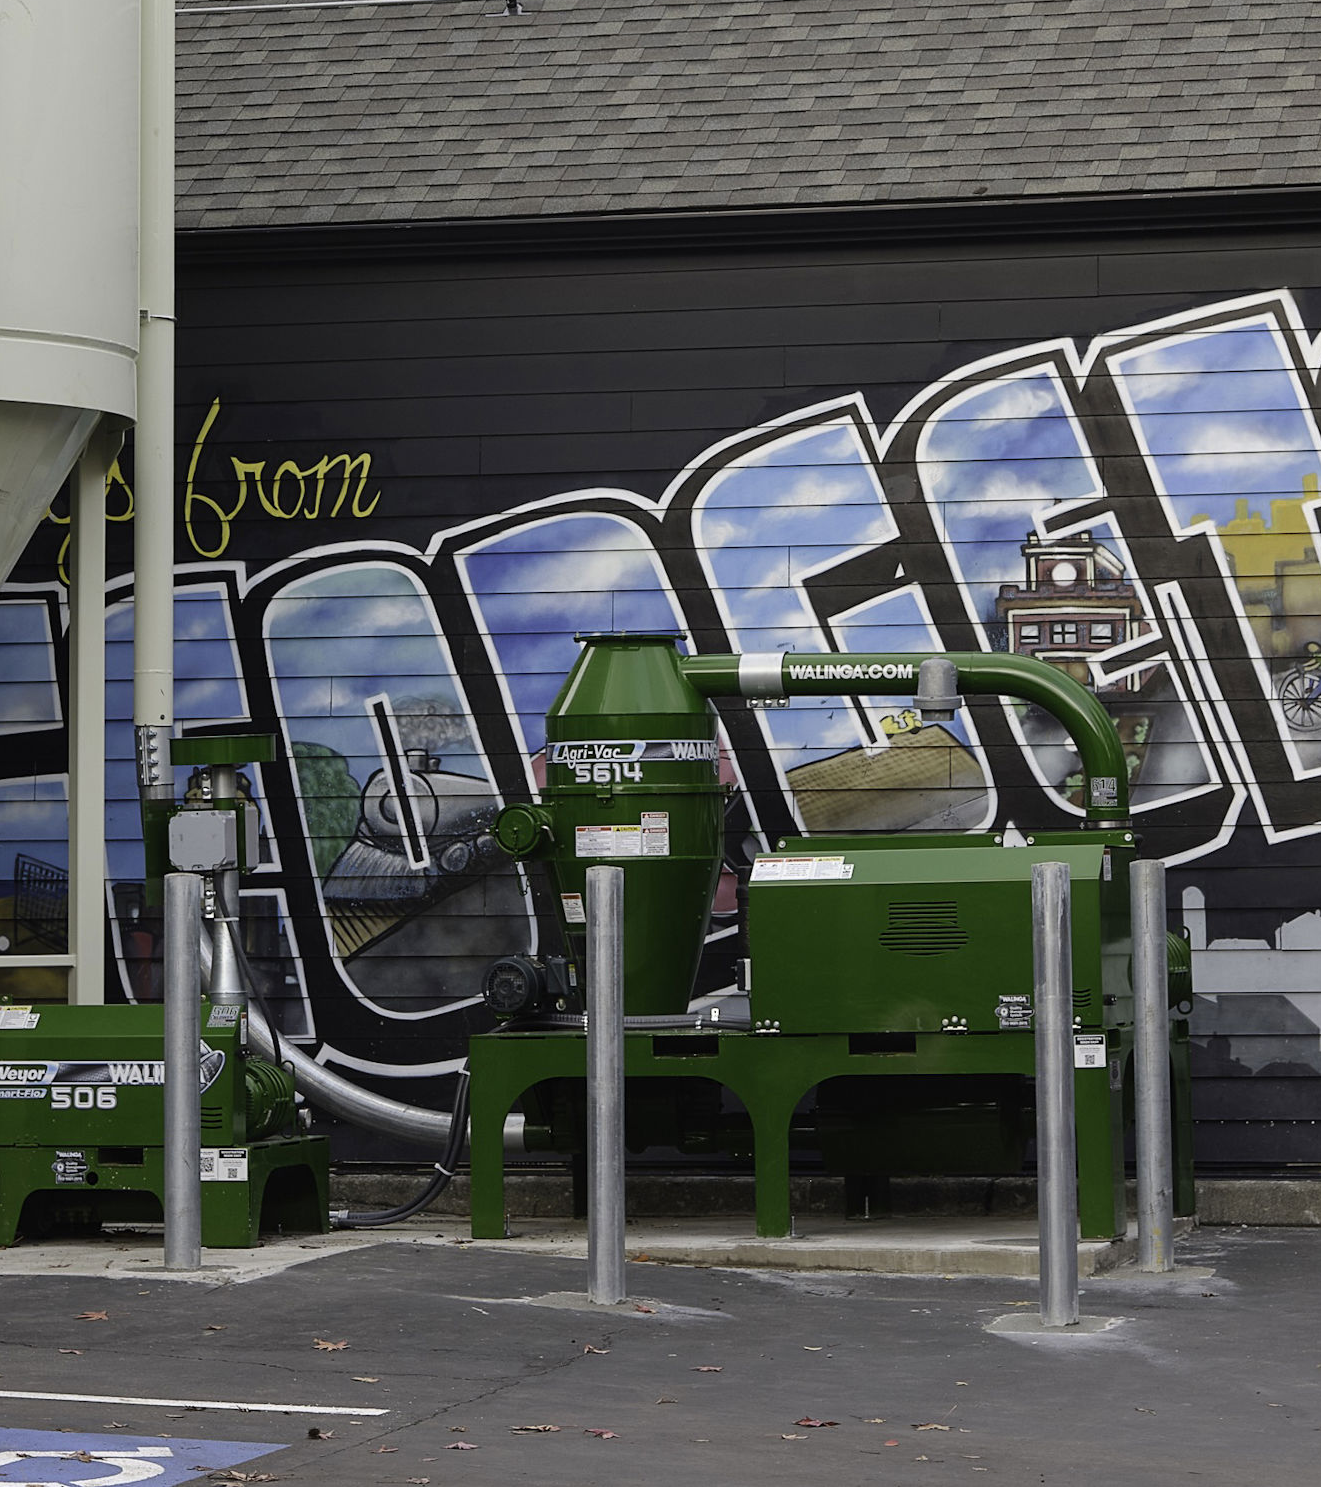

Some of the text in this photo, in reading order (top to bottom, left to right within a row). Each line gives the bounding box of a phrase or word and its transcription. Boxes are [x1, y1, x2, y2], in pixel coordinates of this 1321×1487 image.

[184, 397, 381, 558] from
[789, 664, 913, 679] WALINGA.COM
[562, 744, 621, 769] Agri-Vac
[575, 763, 643, 784] 5614
[51, 1086, 117, 1109] 506
